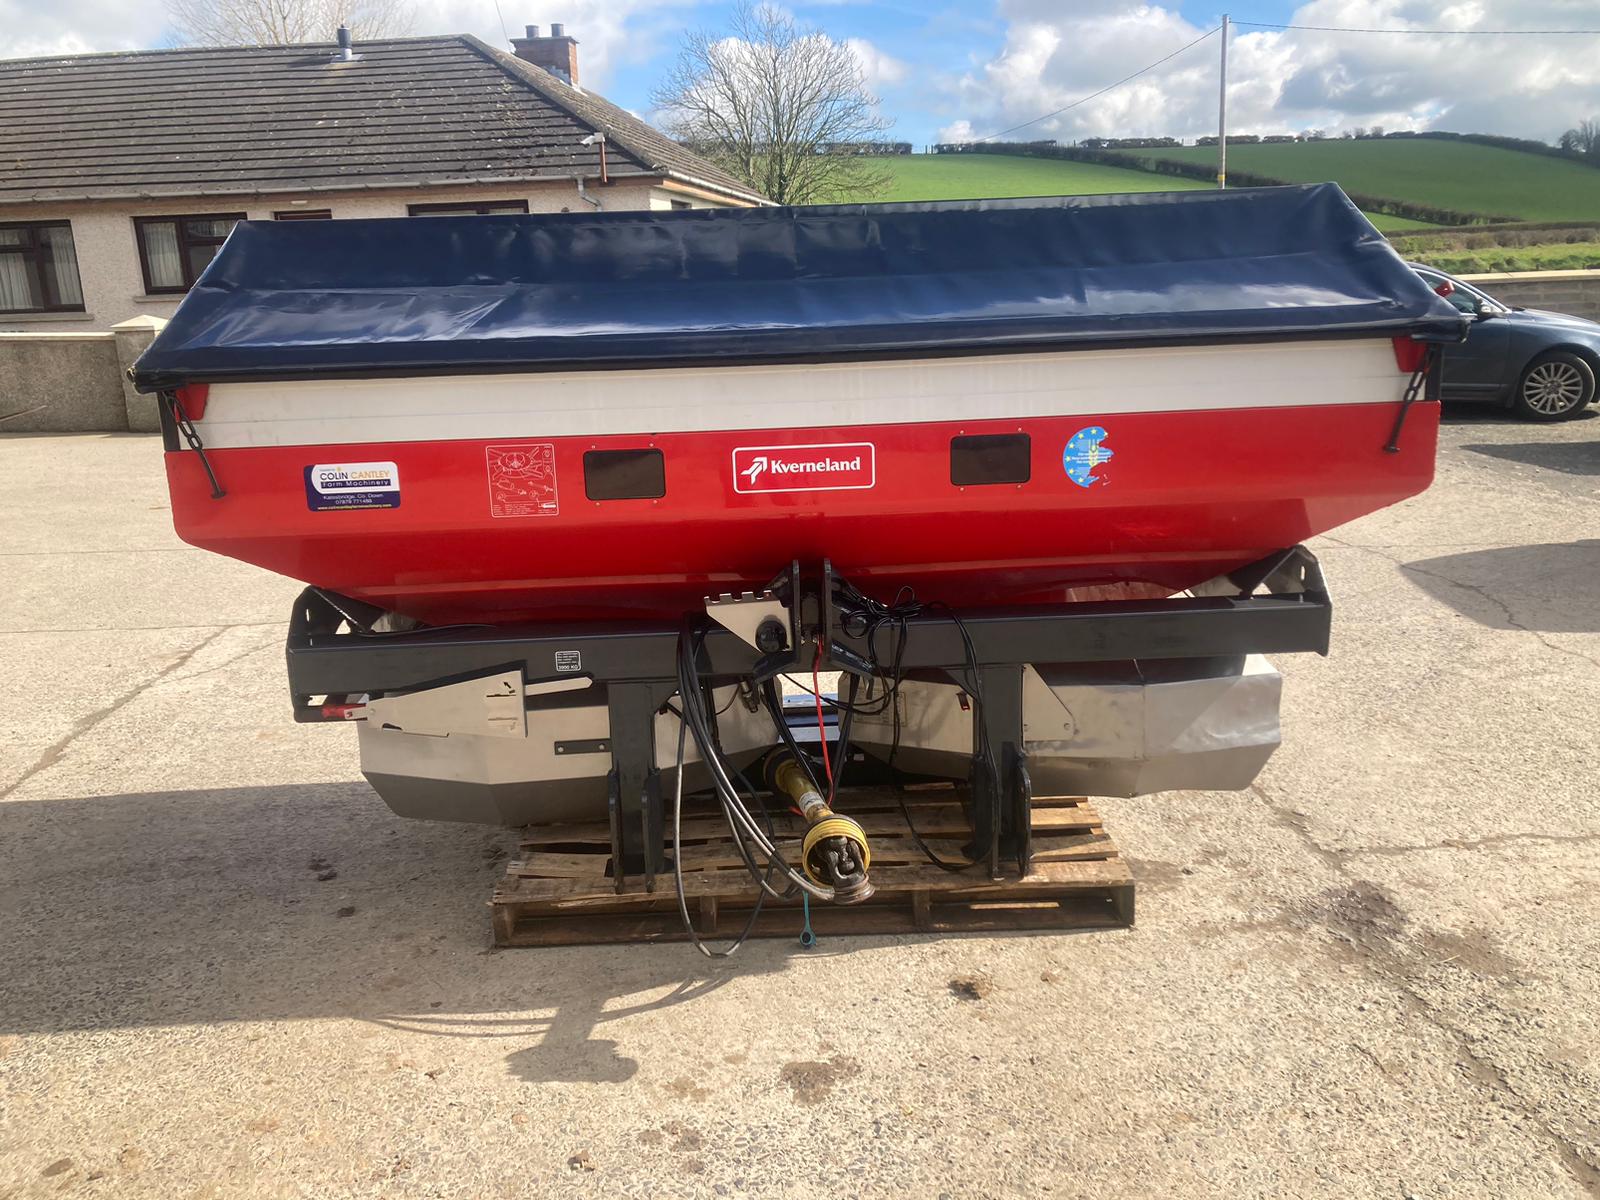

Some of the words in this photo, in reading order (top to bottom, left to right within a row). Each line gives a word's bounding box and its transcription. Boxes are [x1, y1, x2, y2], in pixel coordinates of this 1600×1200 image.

[771, 456, 861, 474] Kverneland
[320, 472, 348, 480] COLIN
[351, 470, 390, 480] CANTLEY
[346, 479, 389, 487] Machinery
